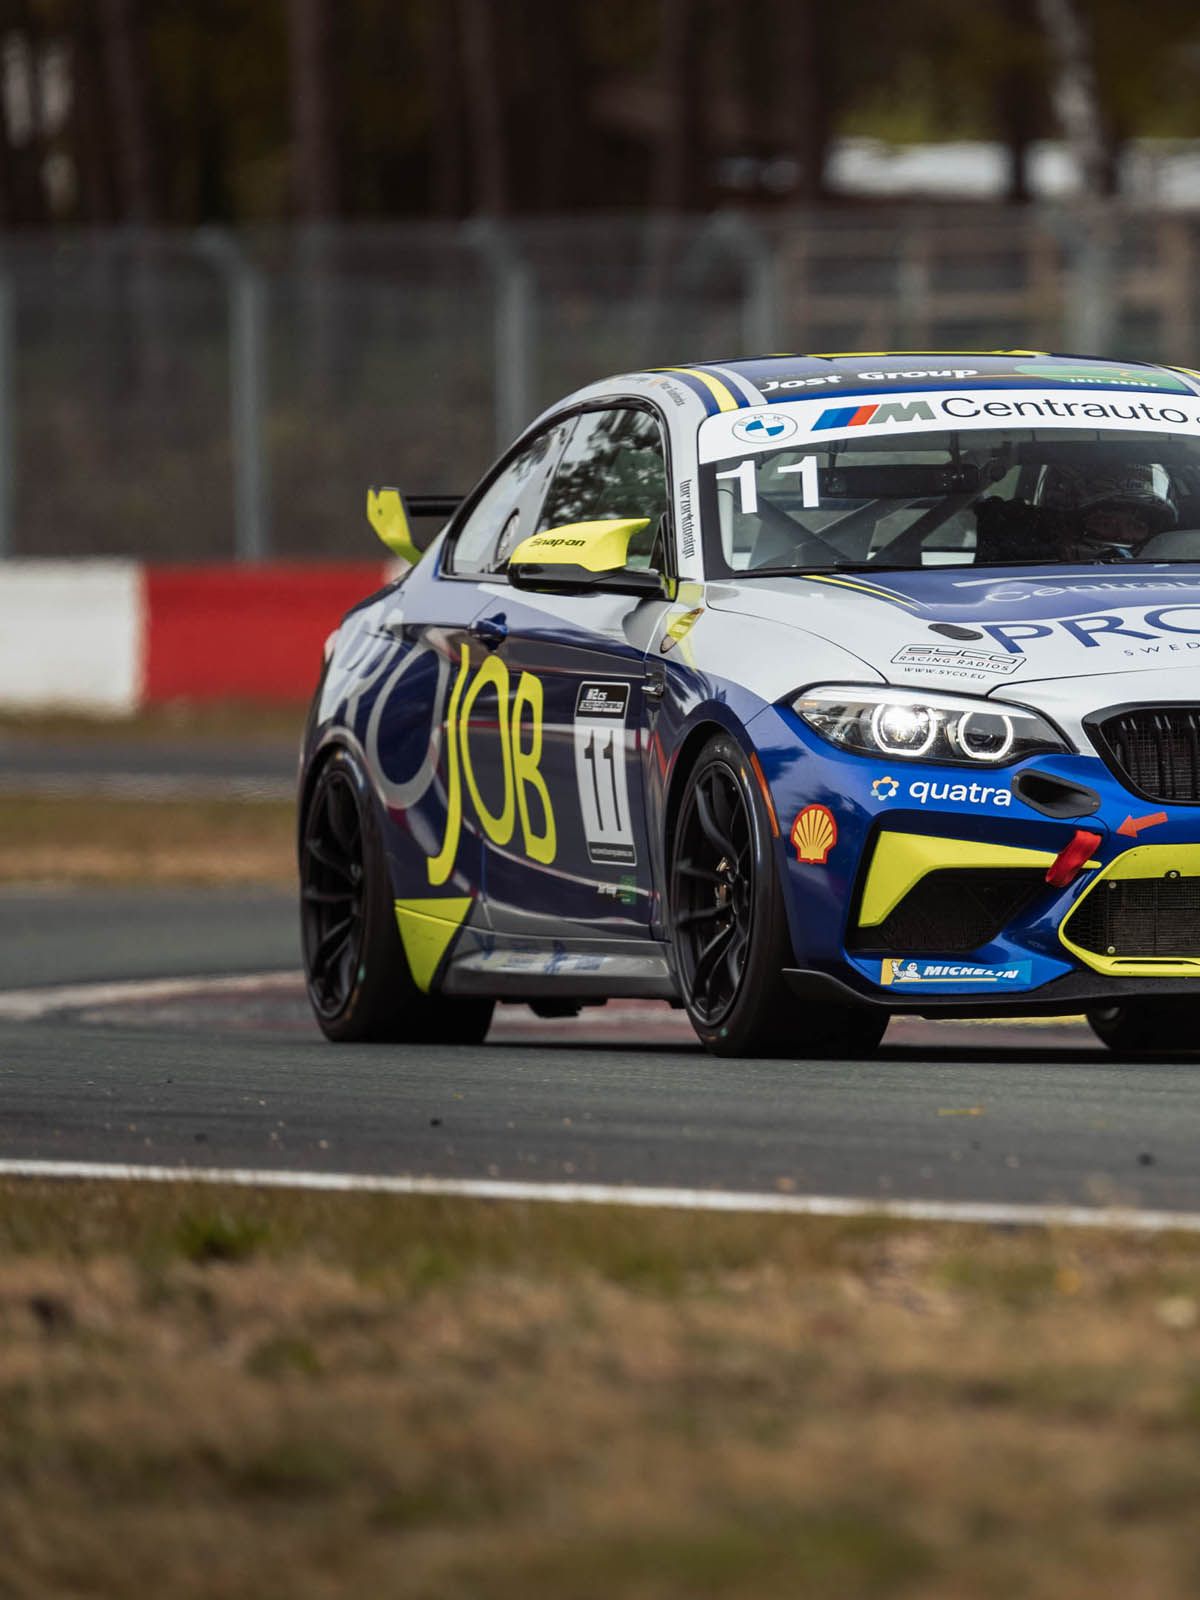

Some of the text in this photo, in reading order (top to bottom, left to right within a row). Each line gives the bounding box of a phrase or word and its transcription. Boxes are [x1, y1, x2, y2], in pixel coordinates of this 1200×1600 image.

[760, 368, 979, 392] Jost Group
[941, 397, 1188, 424] Centrauto
[716, 455, 819, 514] 11
[530, 538, 585, 547] Snap-on
[899, 655, 1009, 671] RACING RADIOS
[583, 729, 622, 831] 11
[909, 779, 1012, 807] quatra
[923, 965, 1019, 979] MICHELIN
